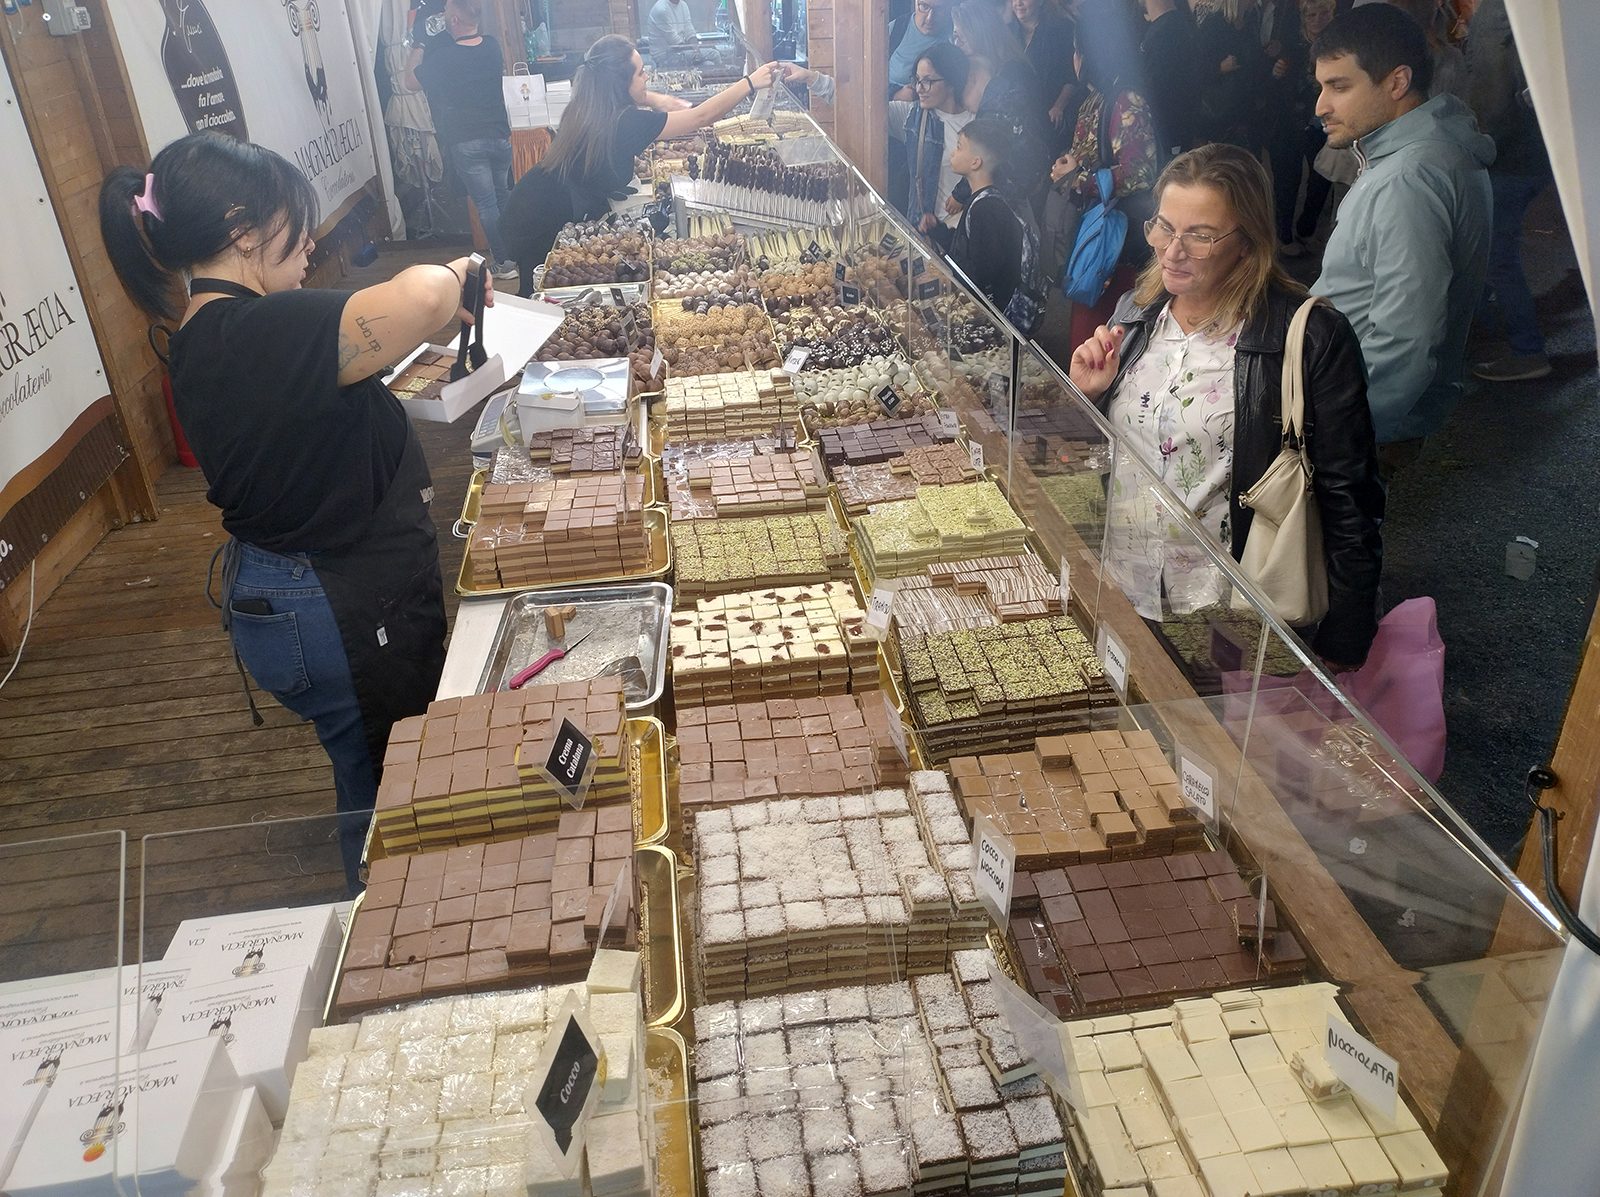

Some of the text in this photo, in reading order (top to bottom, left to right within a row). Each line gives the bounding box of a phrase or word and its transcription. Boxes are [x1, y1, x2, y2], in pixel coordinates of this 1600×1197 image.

[0, 291, 76, 379] GRÆCIA
[558, 738, 573, 765] Crema
[566, 743, 584, 779] Catalana
[981, 839, 999, 862] COCCO
[980, 858, 1005, 893] NOCCIOLA
[221, 931, 305, 952] MAGNAGRÆCIA
[181, 995, 278, 1024] MAGNAGRÆCIA
[10, 1031, 112, 1063] MAGNAGRÆCIA
[1328, 1027, 1395, 1088] NOCCIOLATA
[560, 1060, 581, 1105] Cocco
